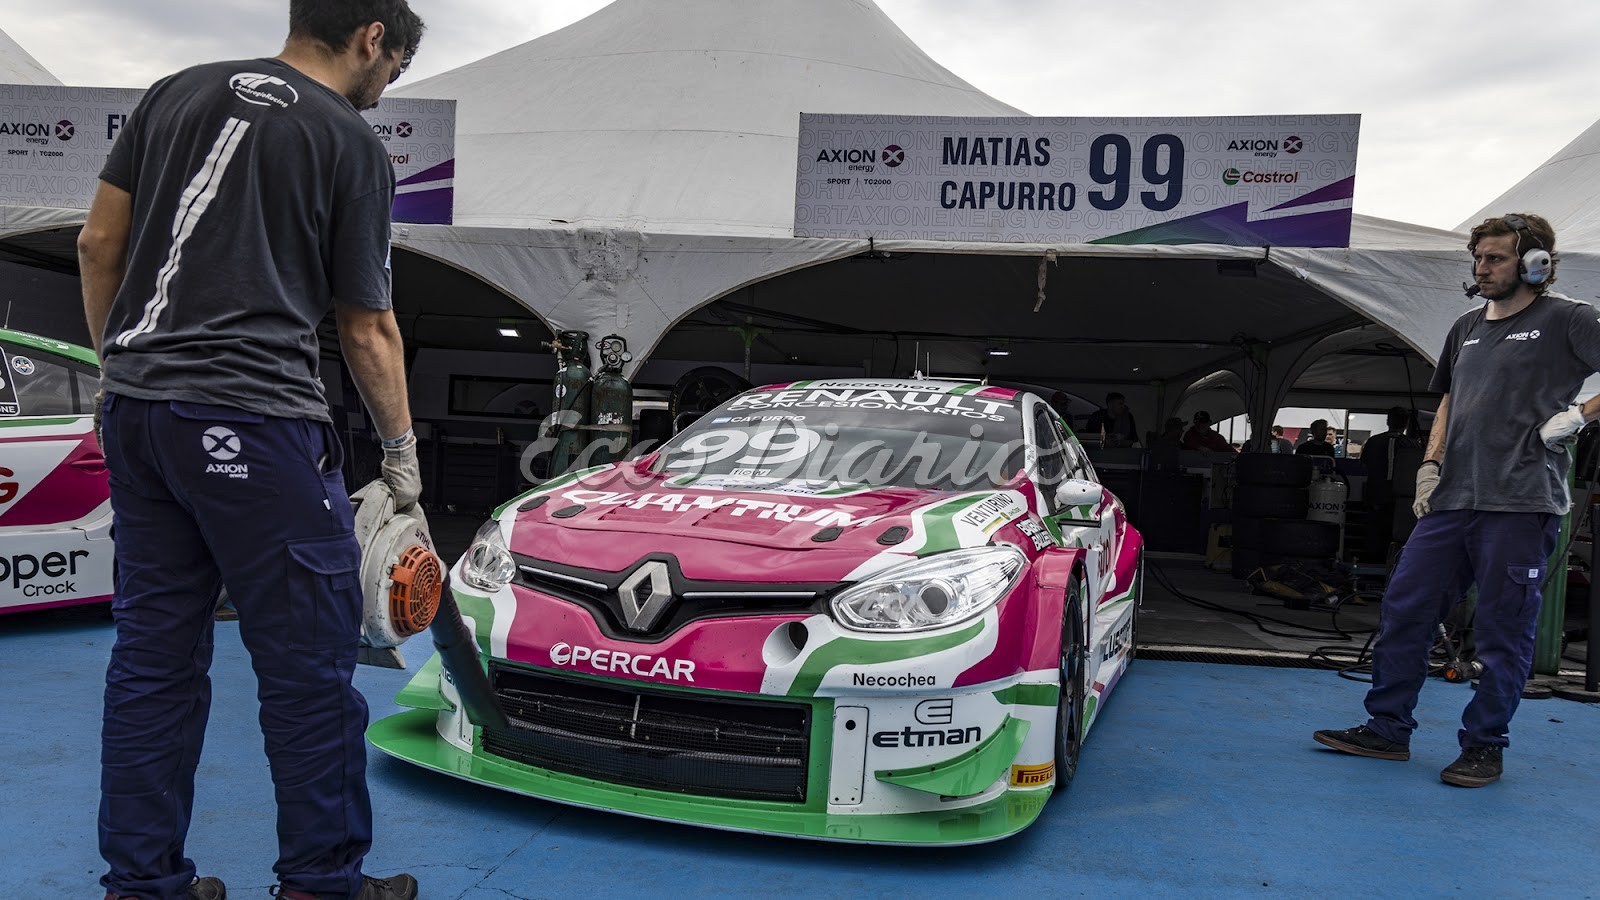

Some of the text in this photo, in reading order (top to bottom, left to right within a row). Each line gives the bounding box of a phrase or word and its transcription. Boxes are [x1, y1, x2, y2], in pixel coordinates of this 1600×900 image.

[943, 136, 1051, 167] MATIAS
[1227, 139, 1278, 151] AXION
[816, 149, 876, 163] AXION
[848, 164, 875, 172] energy
[1087, 133, 1185, 212] 99
[1243, 170, 1299, 183] Castrol
[940, 180, 1076, 212] CAPURRO
[820, 382, 941, 391] Necochea
[733, 389, 1015, 415] RENAULT
[727, 401, 1005, 422] CONCESIONARIOS
[730, 415, 807, 423] CAPURRO
[666, 427, 821, 469] 99
[205, 463, 249, 473] AXION
[960, 493, 1014, 527] VENTURINO
[1310, 502, 1339, 511] AXION
[415, 528, 430, 550] STIHL
[23, 580, 77, 597] Crock
[853, 672, 936, 688] Necochea
[872, 726, 982, 748] etman
